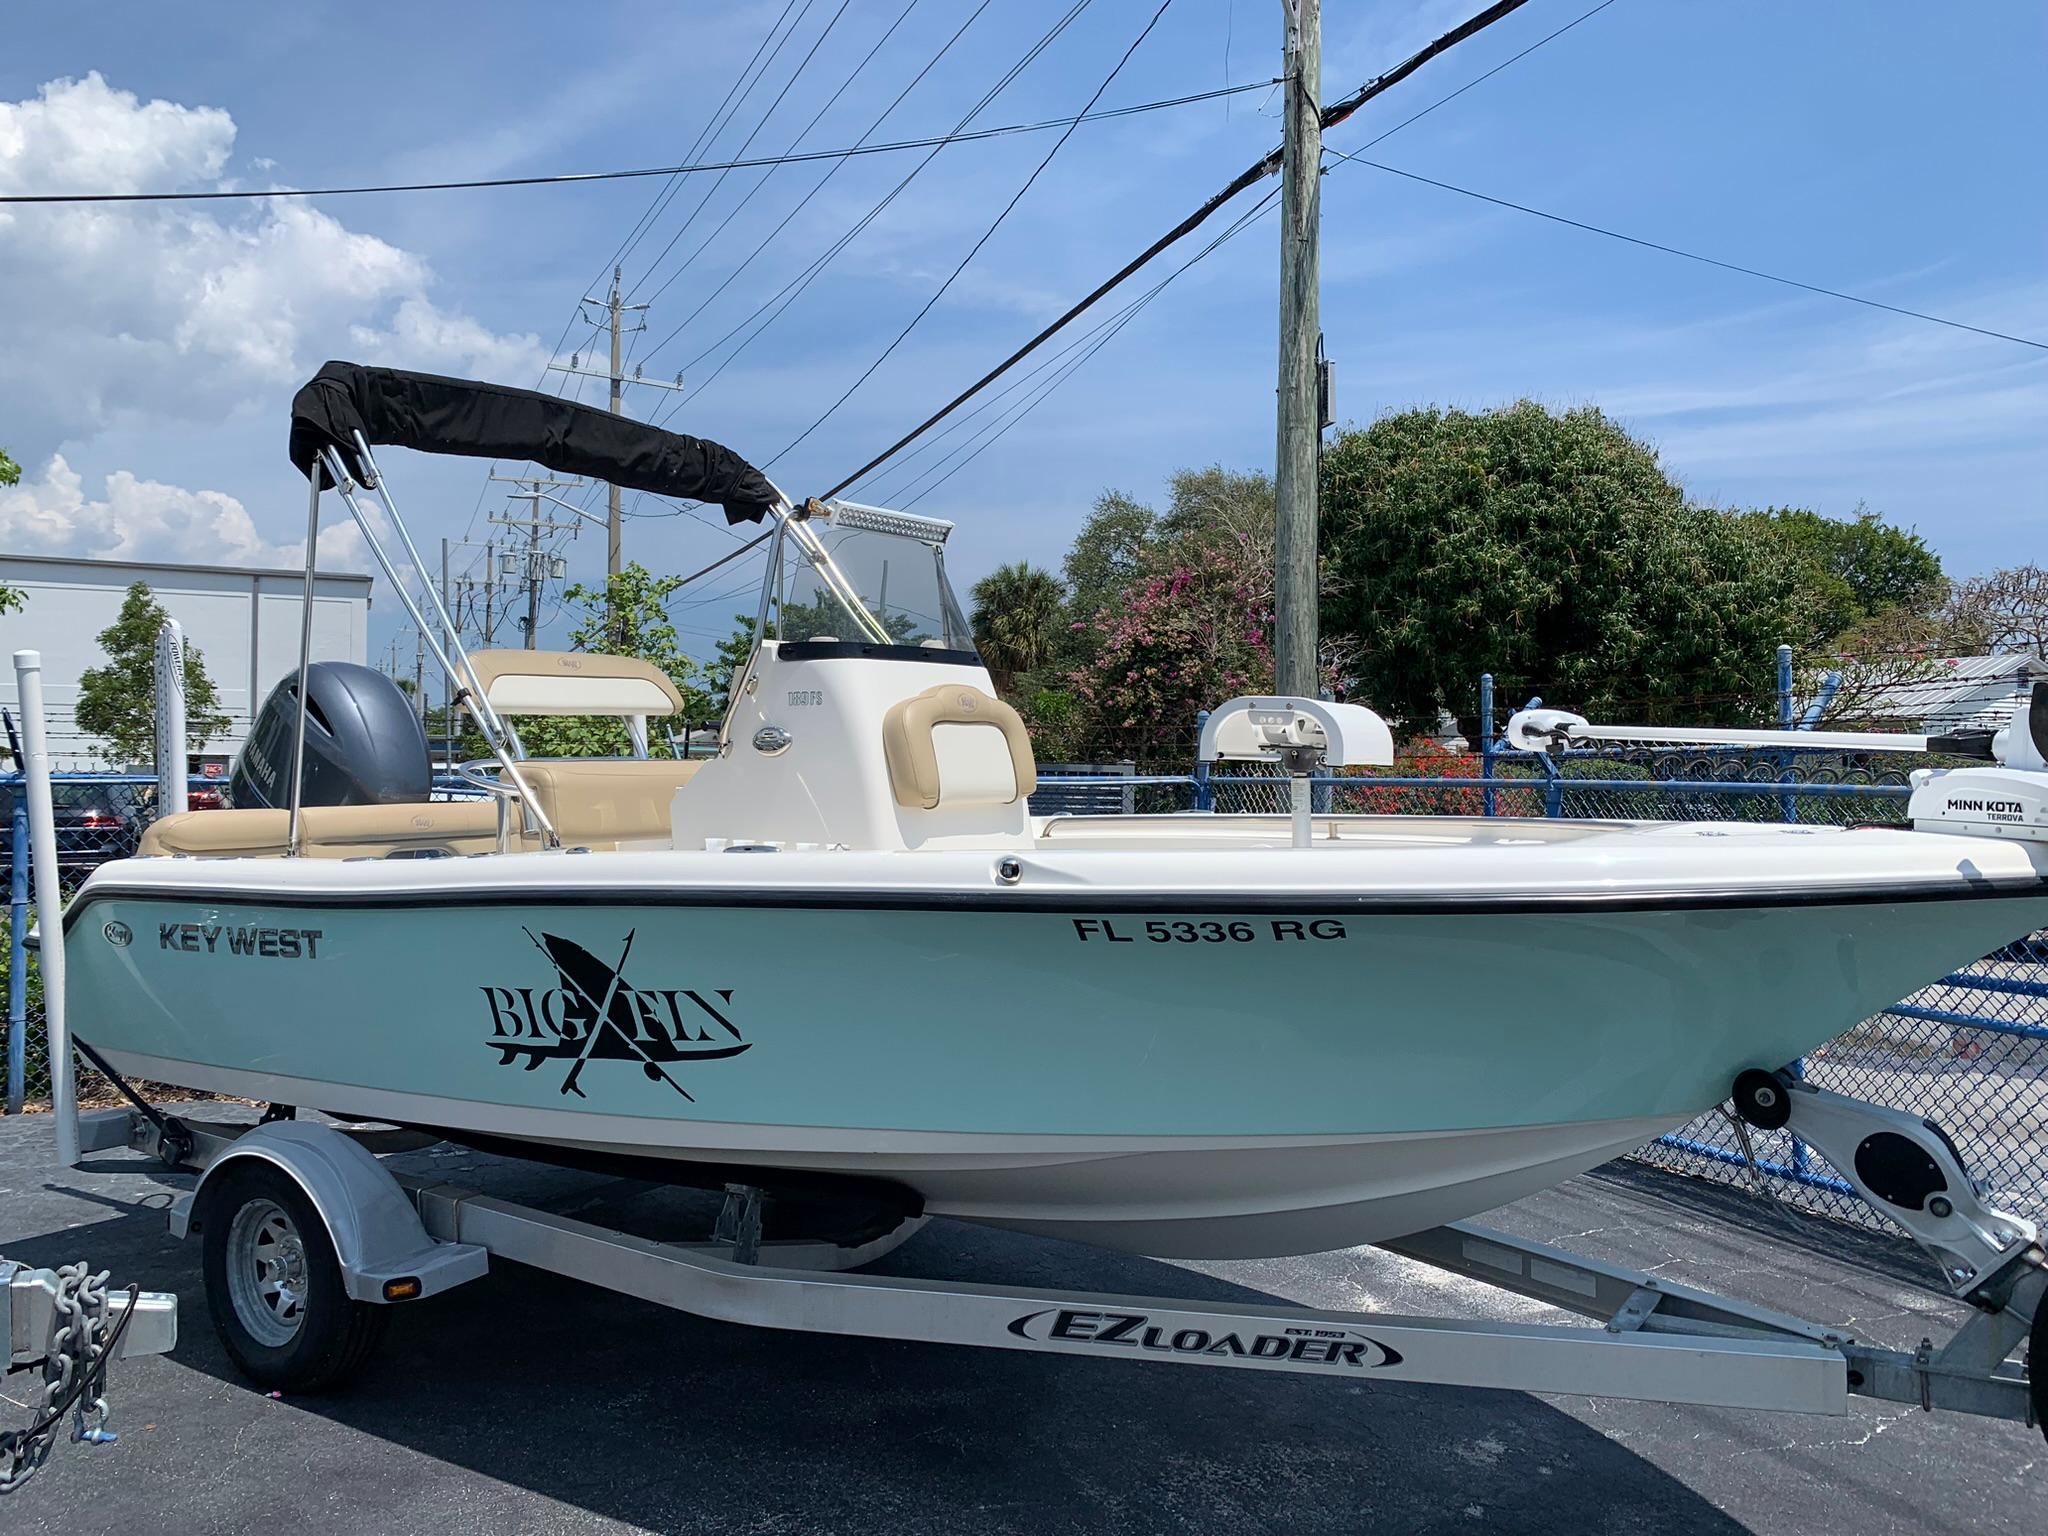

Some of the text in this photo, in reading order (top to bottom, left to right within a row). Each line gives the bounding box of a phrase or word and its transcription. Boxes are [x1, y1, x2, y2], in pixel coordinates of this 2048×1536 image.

[1947, 799, 2023, 813] MINN KOTA
[1987, 812, 2024, 822] TERROVA
[159, 922, 323, 959] KEY WEST
[1072, 919, 1347, 943] FL 5336 RG
[479, 986, 743, 1041] BIG FIN
[1315, 1330, 1346, 1339] 1953
